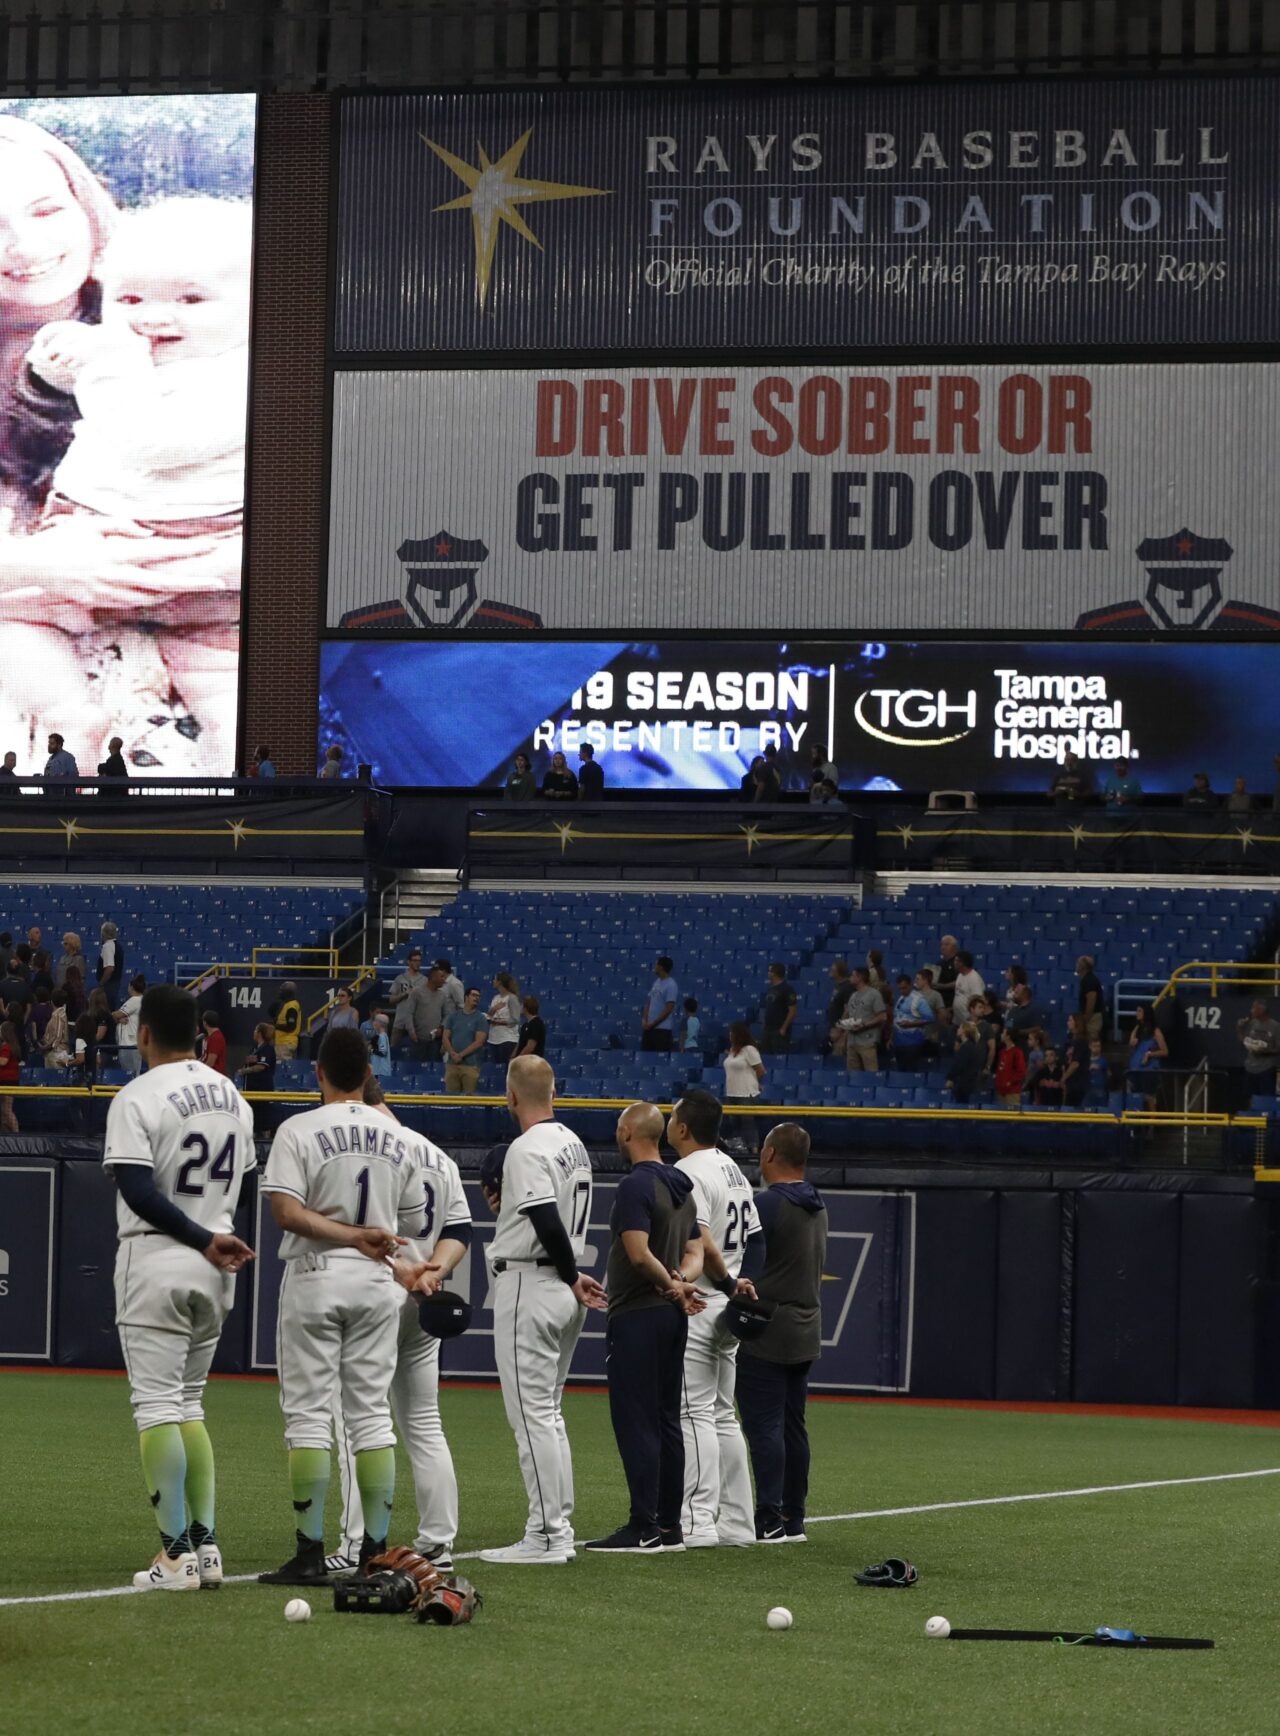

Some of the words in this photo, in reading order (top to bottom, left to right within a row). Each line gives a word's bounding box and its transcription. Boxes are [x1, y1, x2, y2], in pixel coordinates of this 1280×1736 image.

[645, 132, 823, 173] RAYS
[864, 126, 1229, 171] BASEBALL
[648, 190, 1226, 237] FOUNDATION
[644, 257, 752, 295] Official
[762, 257, 874, 293] Charity
[883, 258, 914, 293] of
[920, 257, 965, 286] the
[976, 256, 1079, 292] Tampa
[1088, 256, 1147, 291] Bay
[1156, 255, 1227, 289] Rays
[535, 377, 737, 458] DRIVE
[751, 375, 981, 457] SOBER
[997, 374, 1093, 454] OR
[516, 472, 645, 553] GET
[657, 471, 914, 551] PULLED
[927, 470, 1109, 550] OVER
[626, 671, 808, 711] SEASON
[994, 669, 1107, 702] Tampa
[869, 690, 977, 728] TGH
[994, 701, 1122, 730] General
[760, 721, 808, 752] BY
[228, 987, 262, 1009] 144
[1184, 1006, 1222, 1029] 142
[174, 1132, 237, 1197] 24
[314, 1124, 406, 1167] ADAMES
[354, 1166, 370, 1228] 1
[722, 1200, 752, 1252] 26
[203, 1556, 219, 1569] 24
